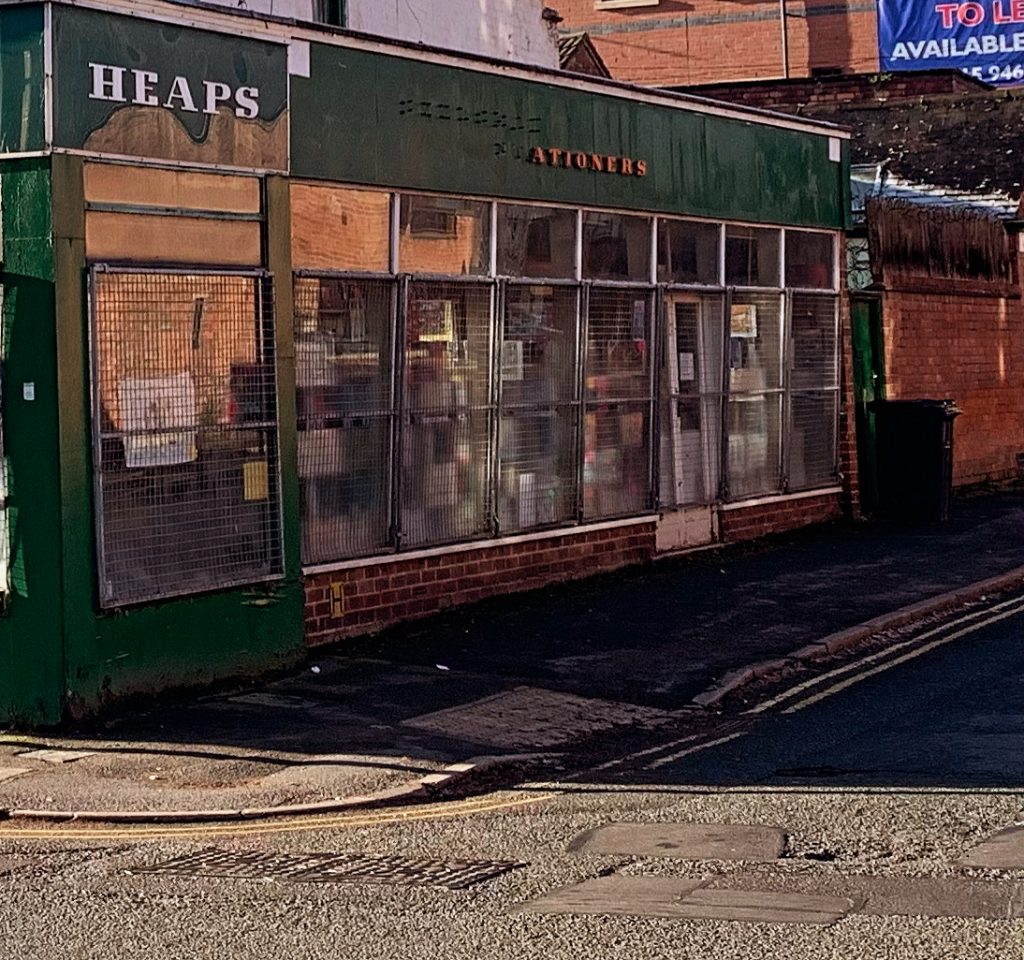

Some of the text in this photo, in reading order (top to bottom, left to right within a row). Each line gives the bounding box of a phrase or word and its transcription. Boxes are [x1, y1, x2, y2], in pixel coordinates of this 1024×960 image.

[935, 2, 985, 29] TO
[890, 32, 1024, 62] AVAILABLE
[988, 64, 1024, 82] 946
[88, 62, 259, 120] HEAPS
